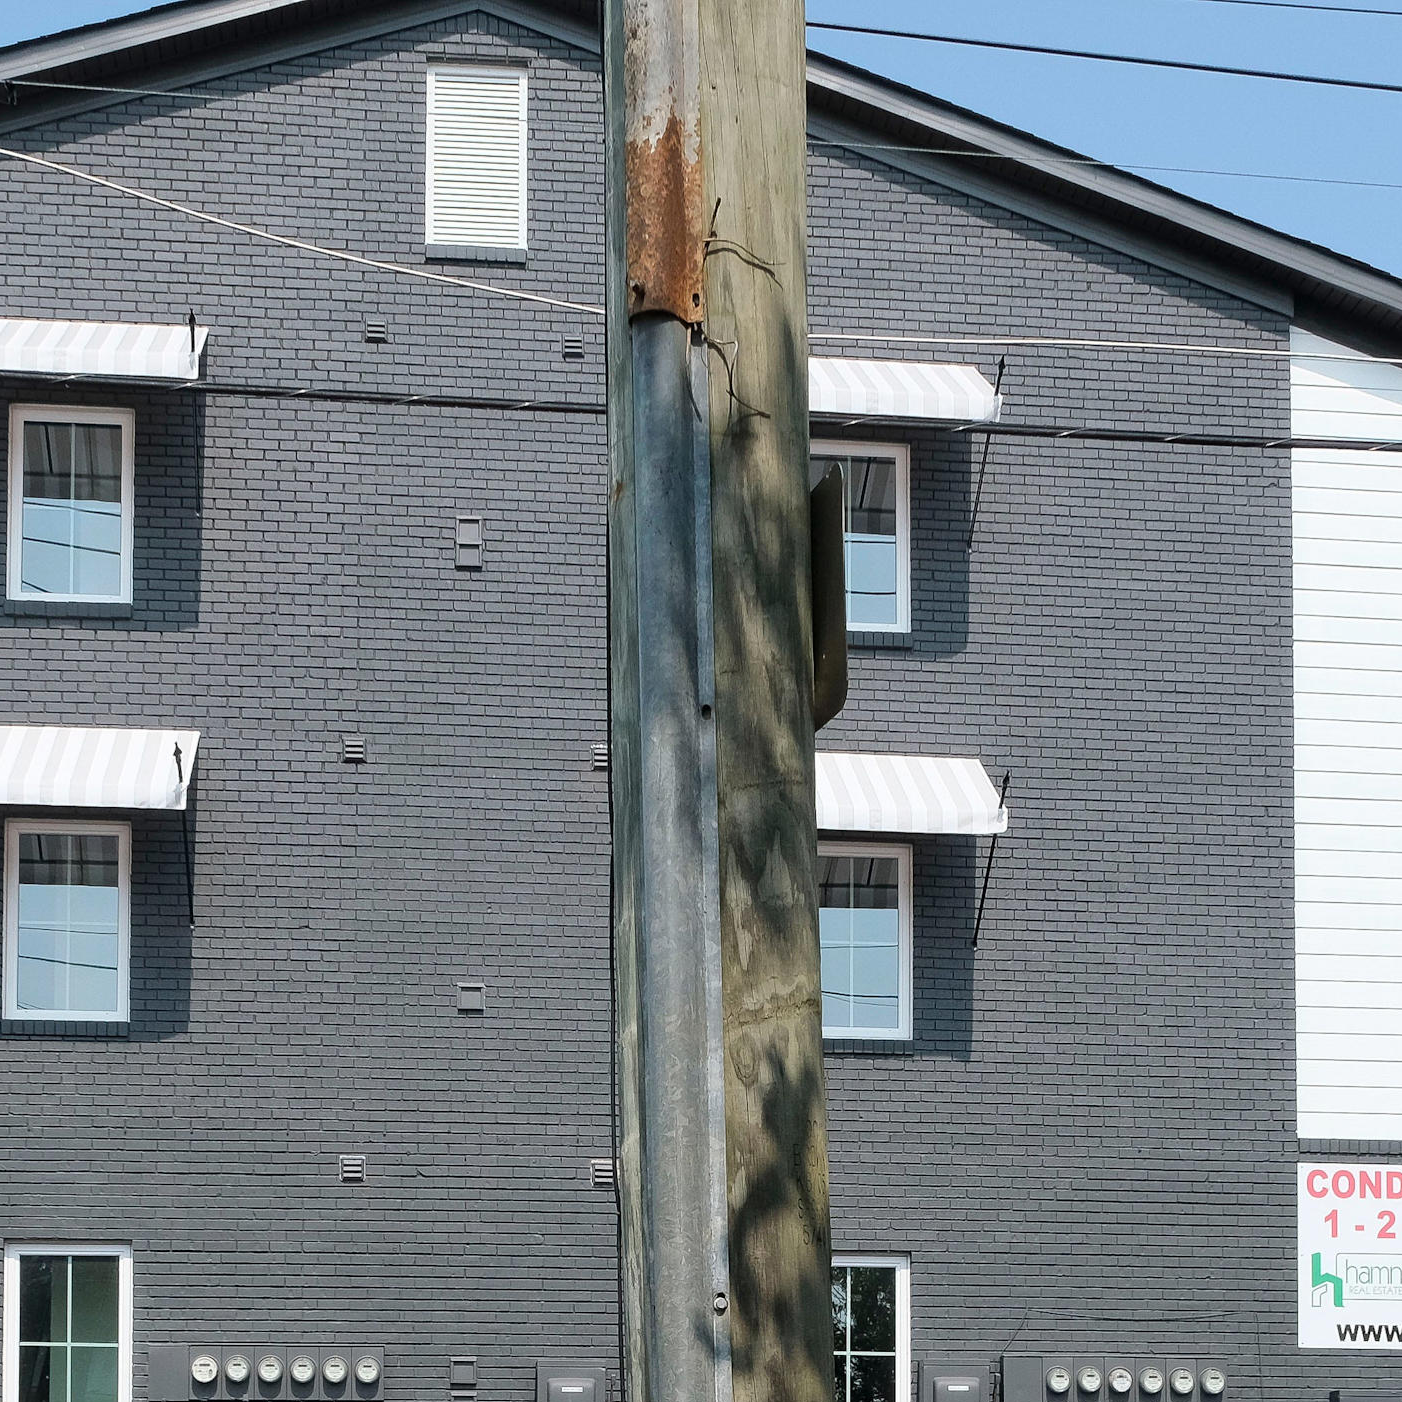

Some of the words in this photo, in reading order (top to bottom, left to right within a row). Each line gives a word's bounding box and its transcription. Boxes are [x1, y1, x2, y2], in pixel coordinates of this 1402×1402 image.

[1324, 1209, 1339, 1238] 1
[1377, 1210, 1396, 1239] 2
[1349, 1285, 1371, 1295] REAL
